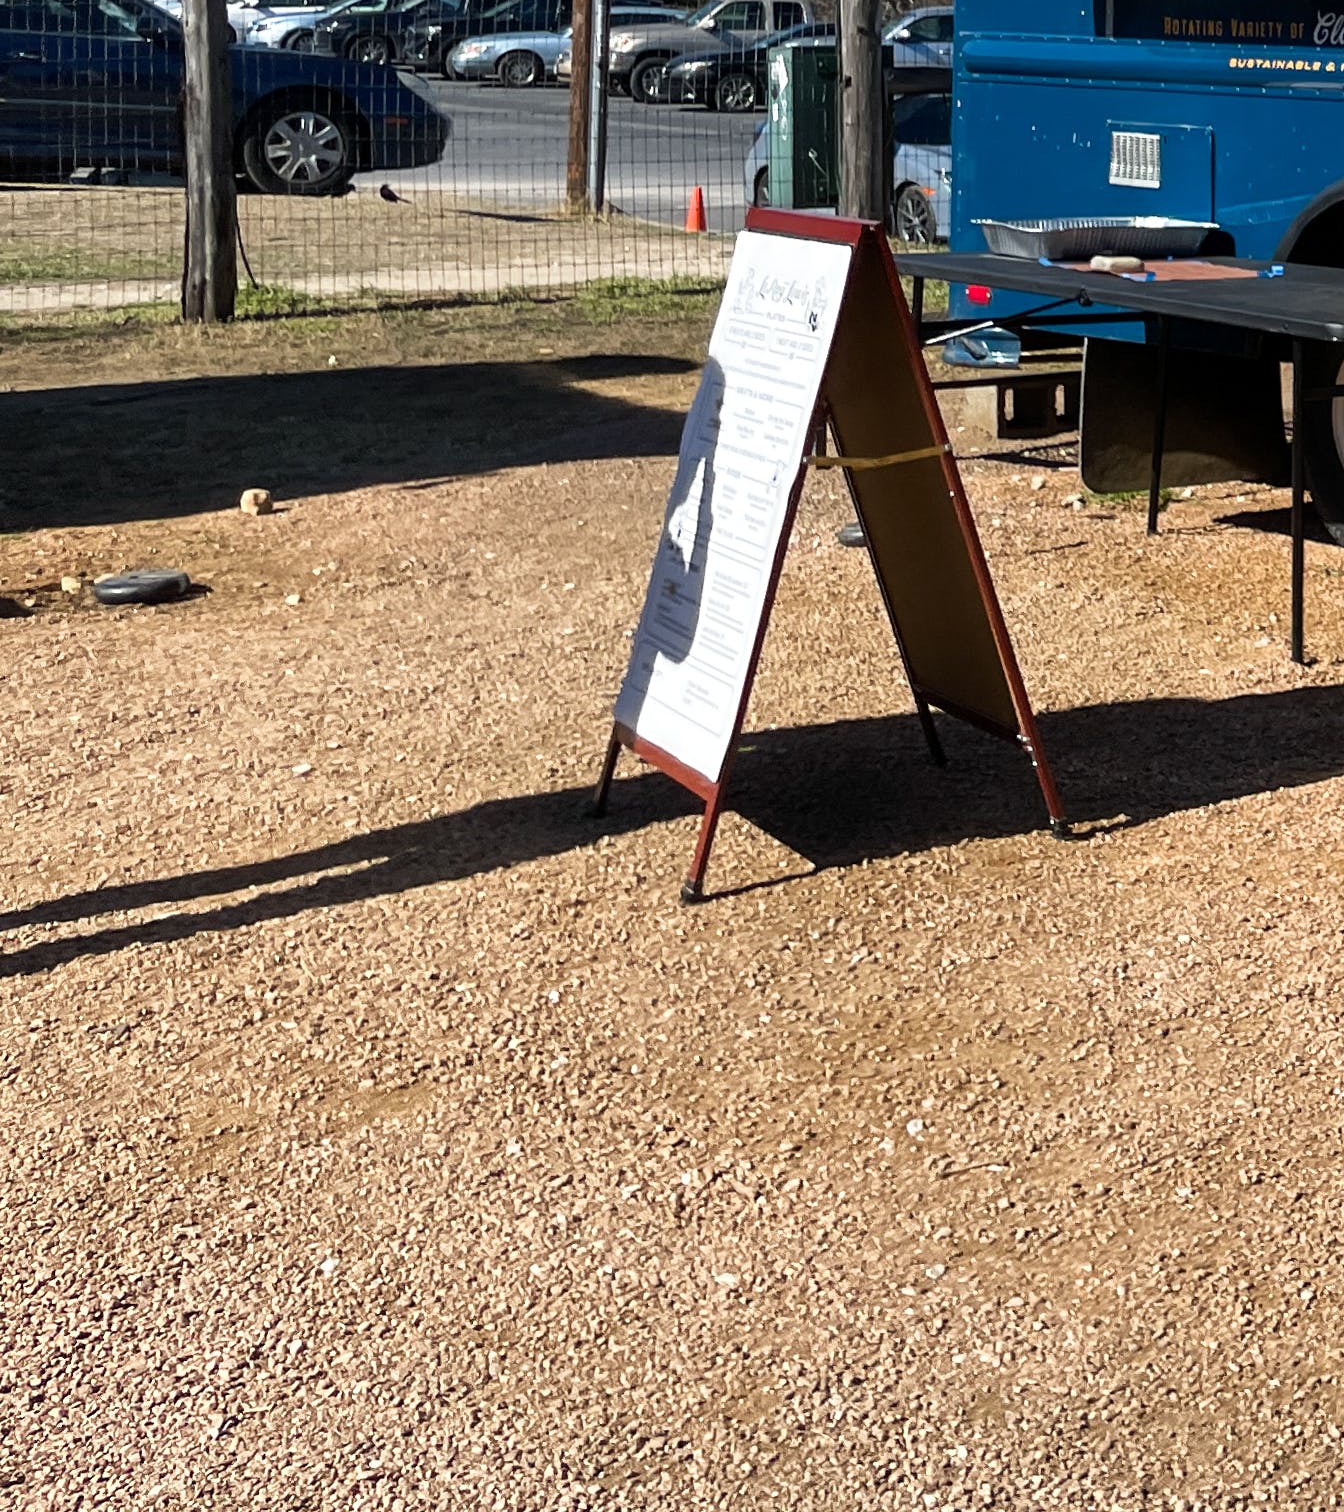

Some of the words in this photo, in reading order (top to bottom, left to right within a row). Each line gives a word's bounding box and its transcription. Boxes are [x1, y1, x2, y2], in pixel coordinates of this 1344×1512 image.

[1230, 18, 1282, 39] VARIETY
[1289, 22, 1304, 39] OF
[1228, 57, 1322, 71] SUSTAINABLE
[1325, 61, 1336, 72] &
